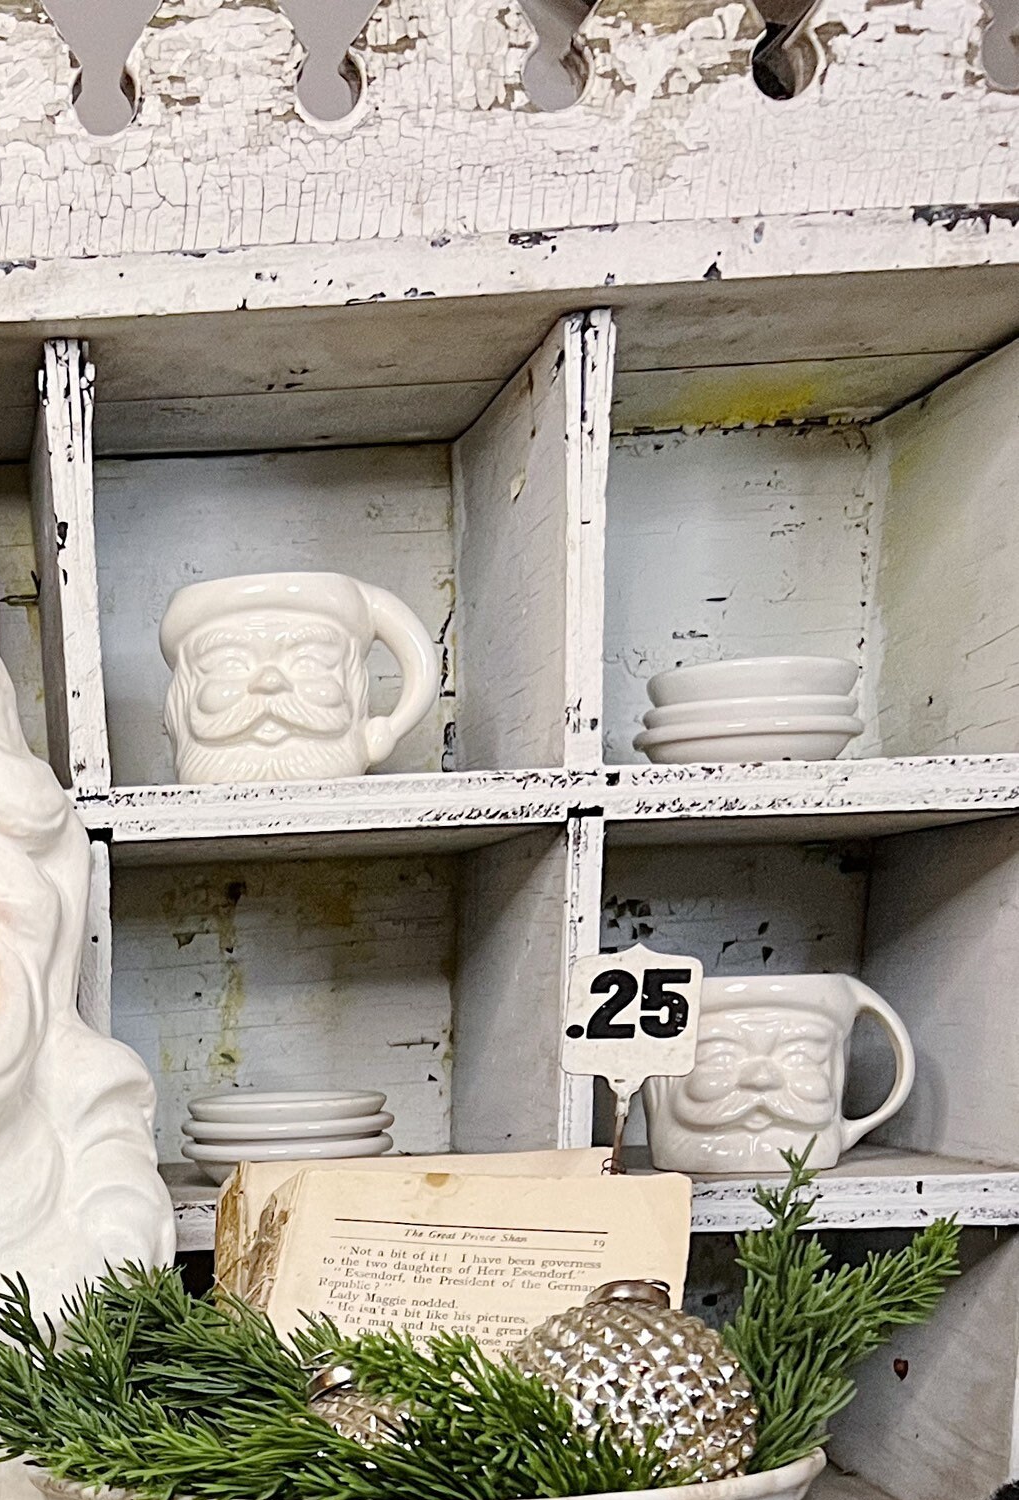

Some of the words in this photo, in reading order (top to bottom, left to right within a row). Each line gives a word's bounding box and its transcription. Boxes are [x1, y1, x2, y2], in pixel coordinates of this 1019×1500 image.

[565, 968, 692, 1039] .25
[404, 1228, 423, 1238] The
[428, 1230, 456, 1240] Great
[461, 1231, 496, 1242] Prince
[592, 1239, 606, 1249] 19
[322, 1256, 335, 1265] to
[341, 1257, 360, 1267] the
[366, 1259, 388, 1269] two
[393, 1261, 453, 1274] daughters
[458, 1264, 472, 1274] of
[477, 1266, 506, 1276] Herr
[377, 1249, 384, 1257] a
[390, 1249, 407, 1260] bit
[412, 1251, 425, 1260] of
[461, 1254, 466, 1263] I
[472, 1254, 502, 1264] have
[508, 1256, 536, 1266] been
[541, 1259, 602, 1269] governess
[413, 1274, 433, 1284] the
[439, 1276, 495, 1288] President
[502, 1279, 515, 1288] of
[521, 1280, 541, 1290] the
[329, 1287, 360, 1302] Lady
[364, 1292, 407, 1307] Maggie
[411, 1298, 459, 1309] nodded.
[344, 1313, 361, 1325] fat
[367, 1318, 394, 1328] man
[401, 1320, 424, 1330] and
[430, 1321, 445, 1331] he
[450, 1324, 476, 1334] eats
[482, 1326, 489, 1334] a
[495, 1326, 528, 1337] great
[359, 1304, 386, 1316] isn't
[391, 1309, 398, 1317] a
[404, 1308, 421, 1319] bit
[426, 1310, 449, 1320] like
[453, 1311, 471, 1321] his
[476, 1314, 530, 1325] pictures.
